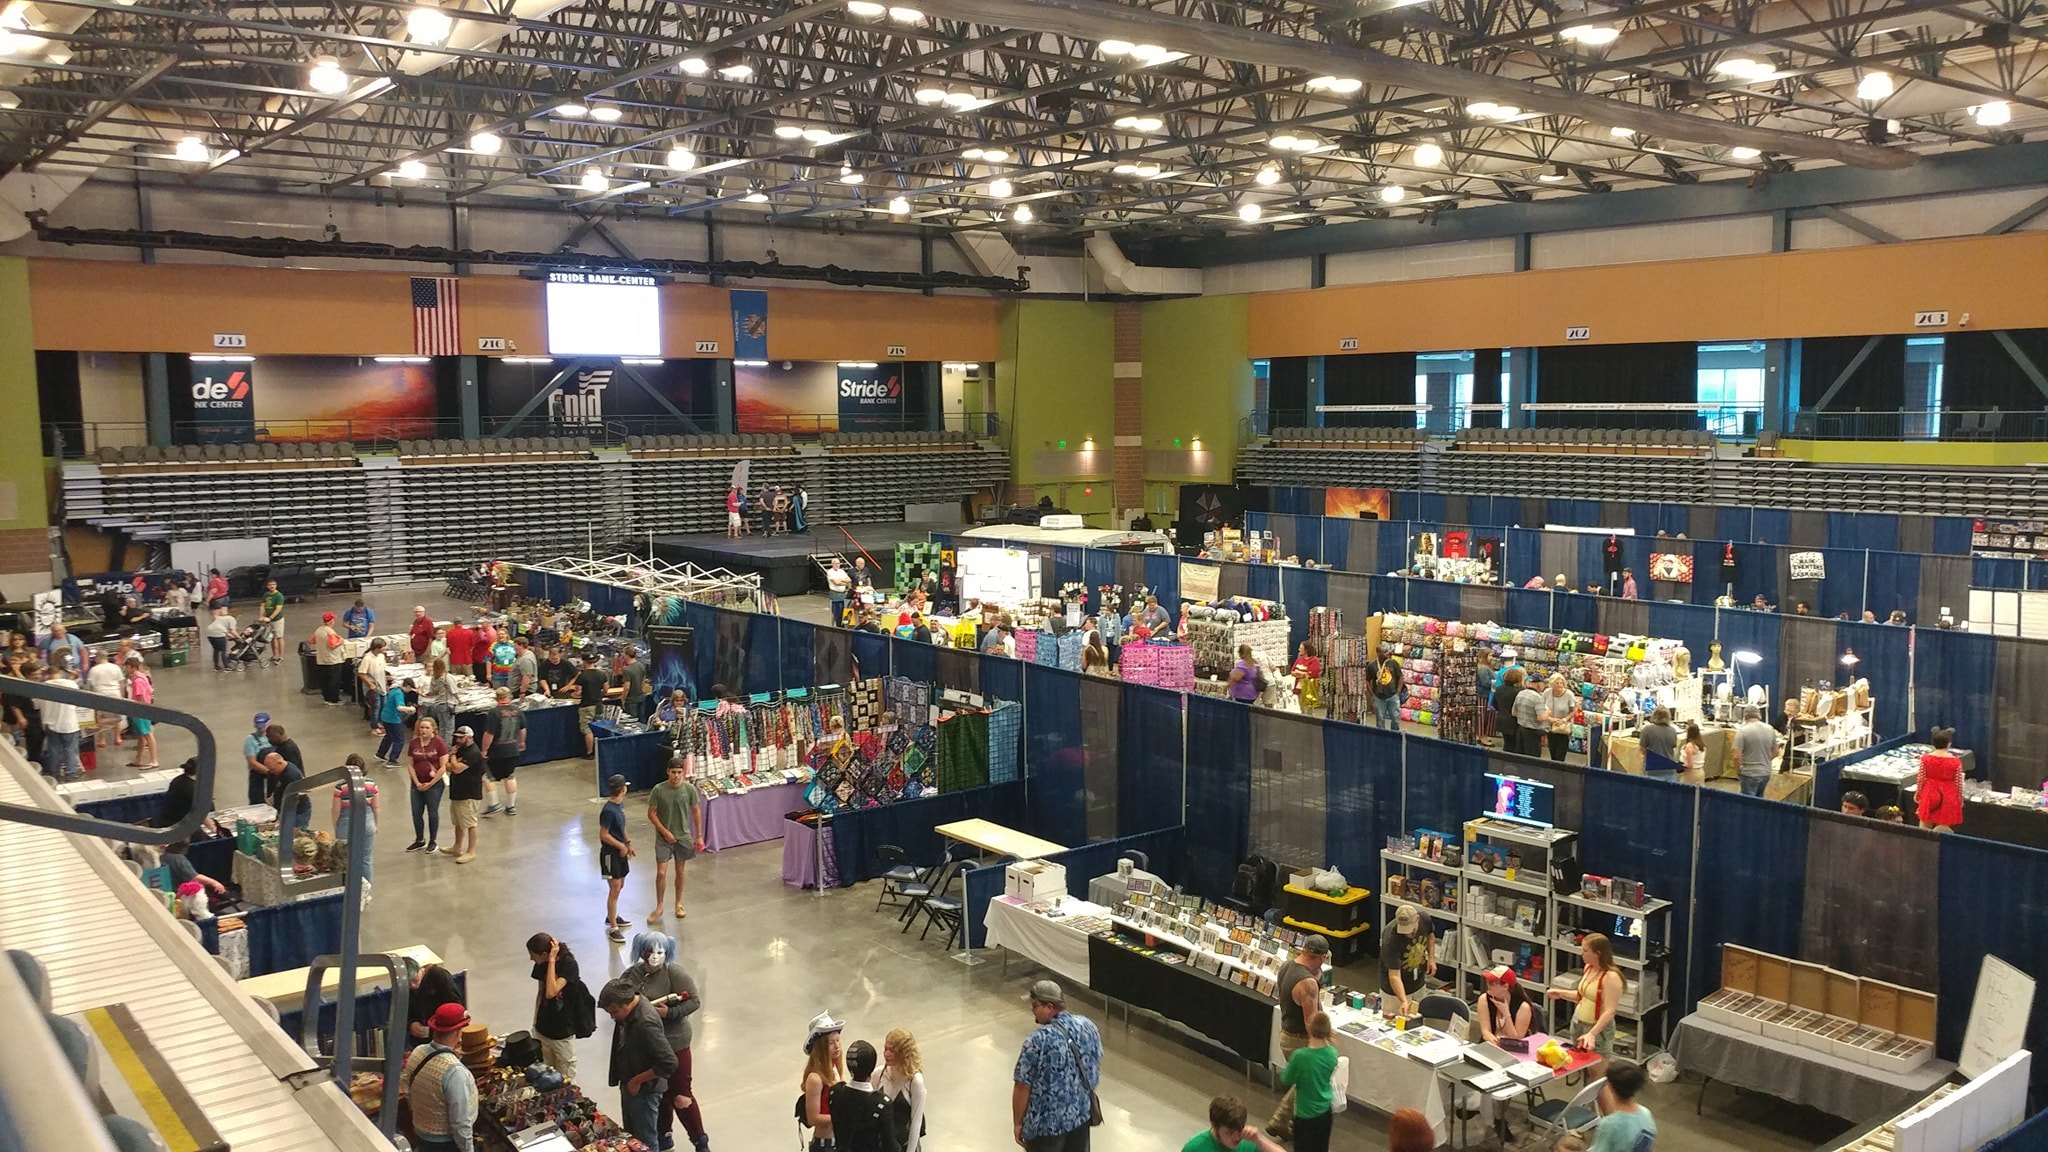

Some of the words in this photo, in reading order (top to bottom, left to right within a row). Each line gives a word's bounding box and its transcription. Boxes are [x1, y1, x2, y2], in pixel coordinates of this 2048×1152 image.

[549, 273, 585, 282] STRIDE
[588, 274, 616, 284] BANK
[618, 276, 655, 286] CENTER
[1918, 314, 1945, 324] 203
[1568, 329, 1588, 338] 202
[218, 336, 243, 345] 215
[697, 343, 716, 351] 217
[889, 347, 904, 355] 218
[840, 379, 888, 398] Stride
[210, 400, 244, 408] CENTER
[96, 581, 133, 595] tride
